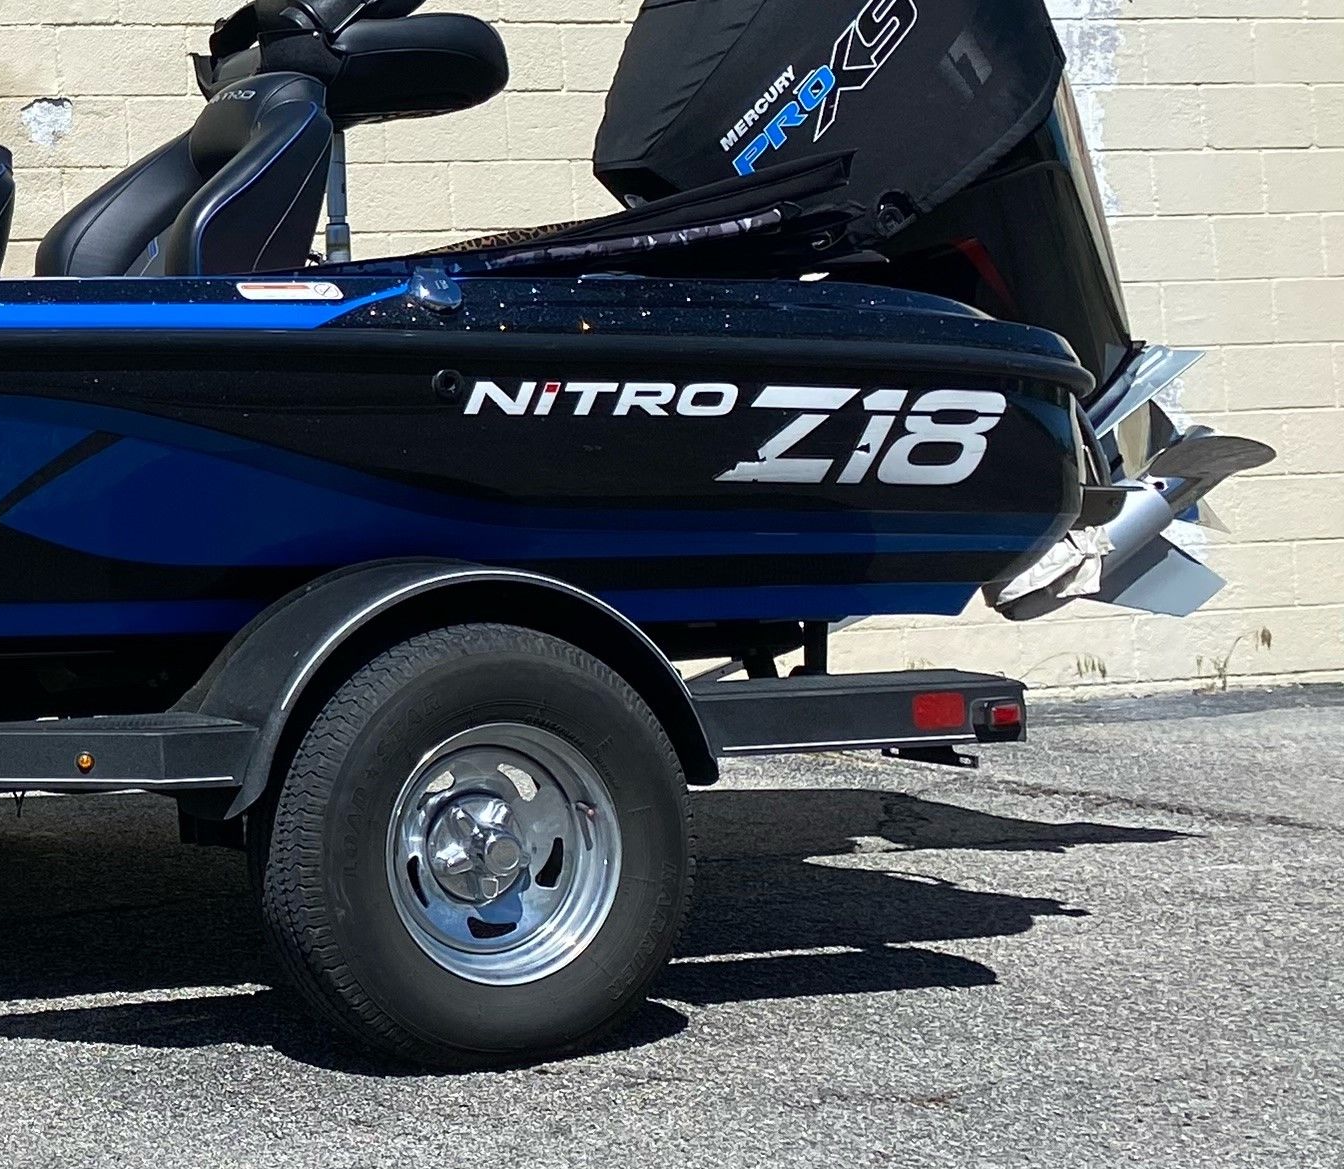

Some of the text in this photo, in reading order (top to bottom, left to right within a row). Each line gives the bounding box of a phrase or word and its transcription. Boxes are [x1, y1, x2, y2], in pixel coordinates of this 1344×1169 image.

[719, 64, 796, 152] MERCURY
[732, 64, 836, 176] PRO
[463, 381, 1008, 485] NITRO Z18
